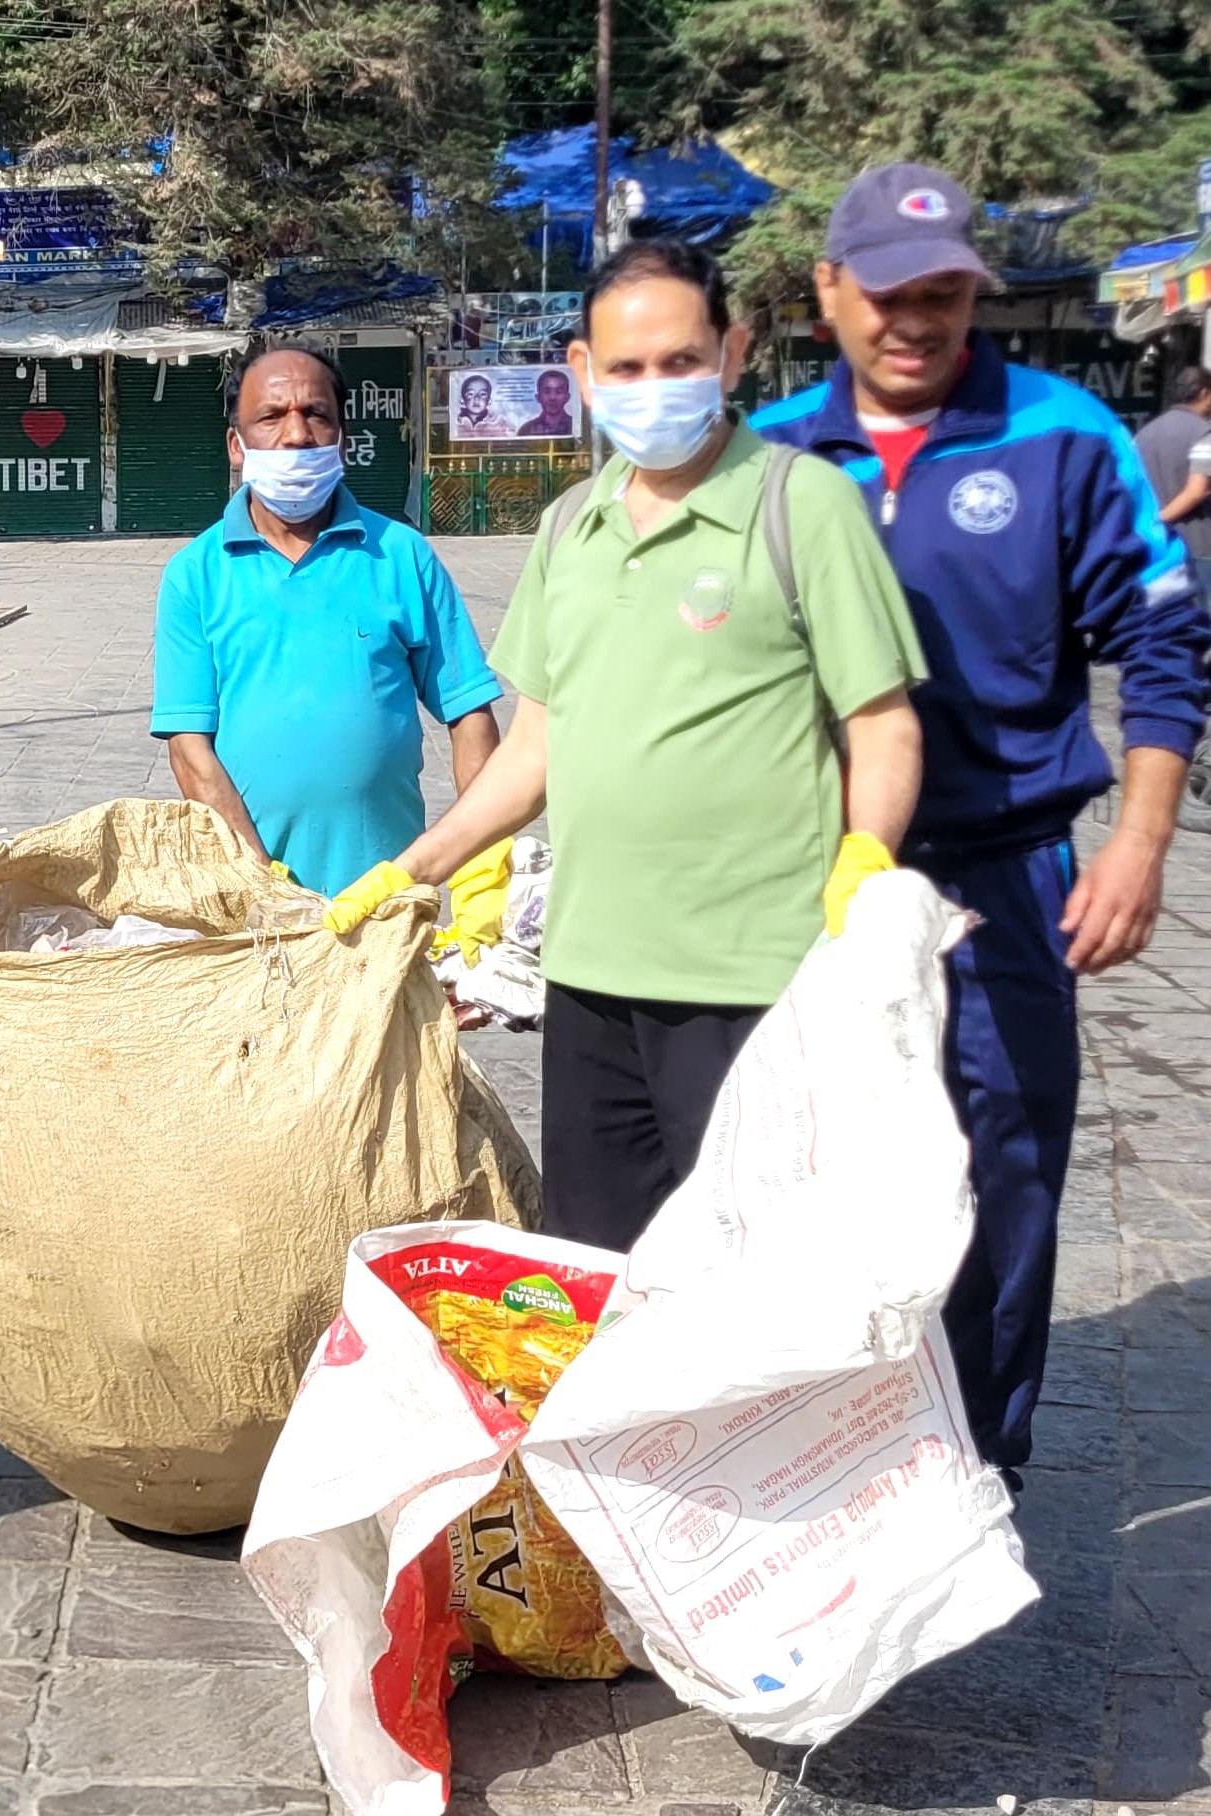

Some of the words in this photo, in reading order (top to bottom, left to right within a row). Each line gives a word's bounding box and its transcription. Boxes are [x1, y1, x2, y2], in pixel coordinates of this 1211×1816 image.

[403, 1256, 471, 1279] ATTA
[505, 1289, 573, 1315] ANCHAL
[518, 1283, 559, 1299] FRESH
[756, 1488, 786, 1510] PARK,
[763, 1514, 844, 1575] Exports
[688, 1569, 763, 1632] Limited
